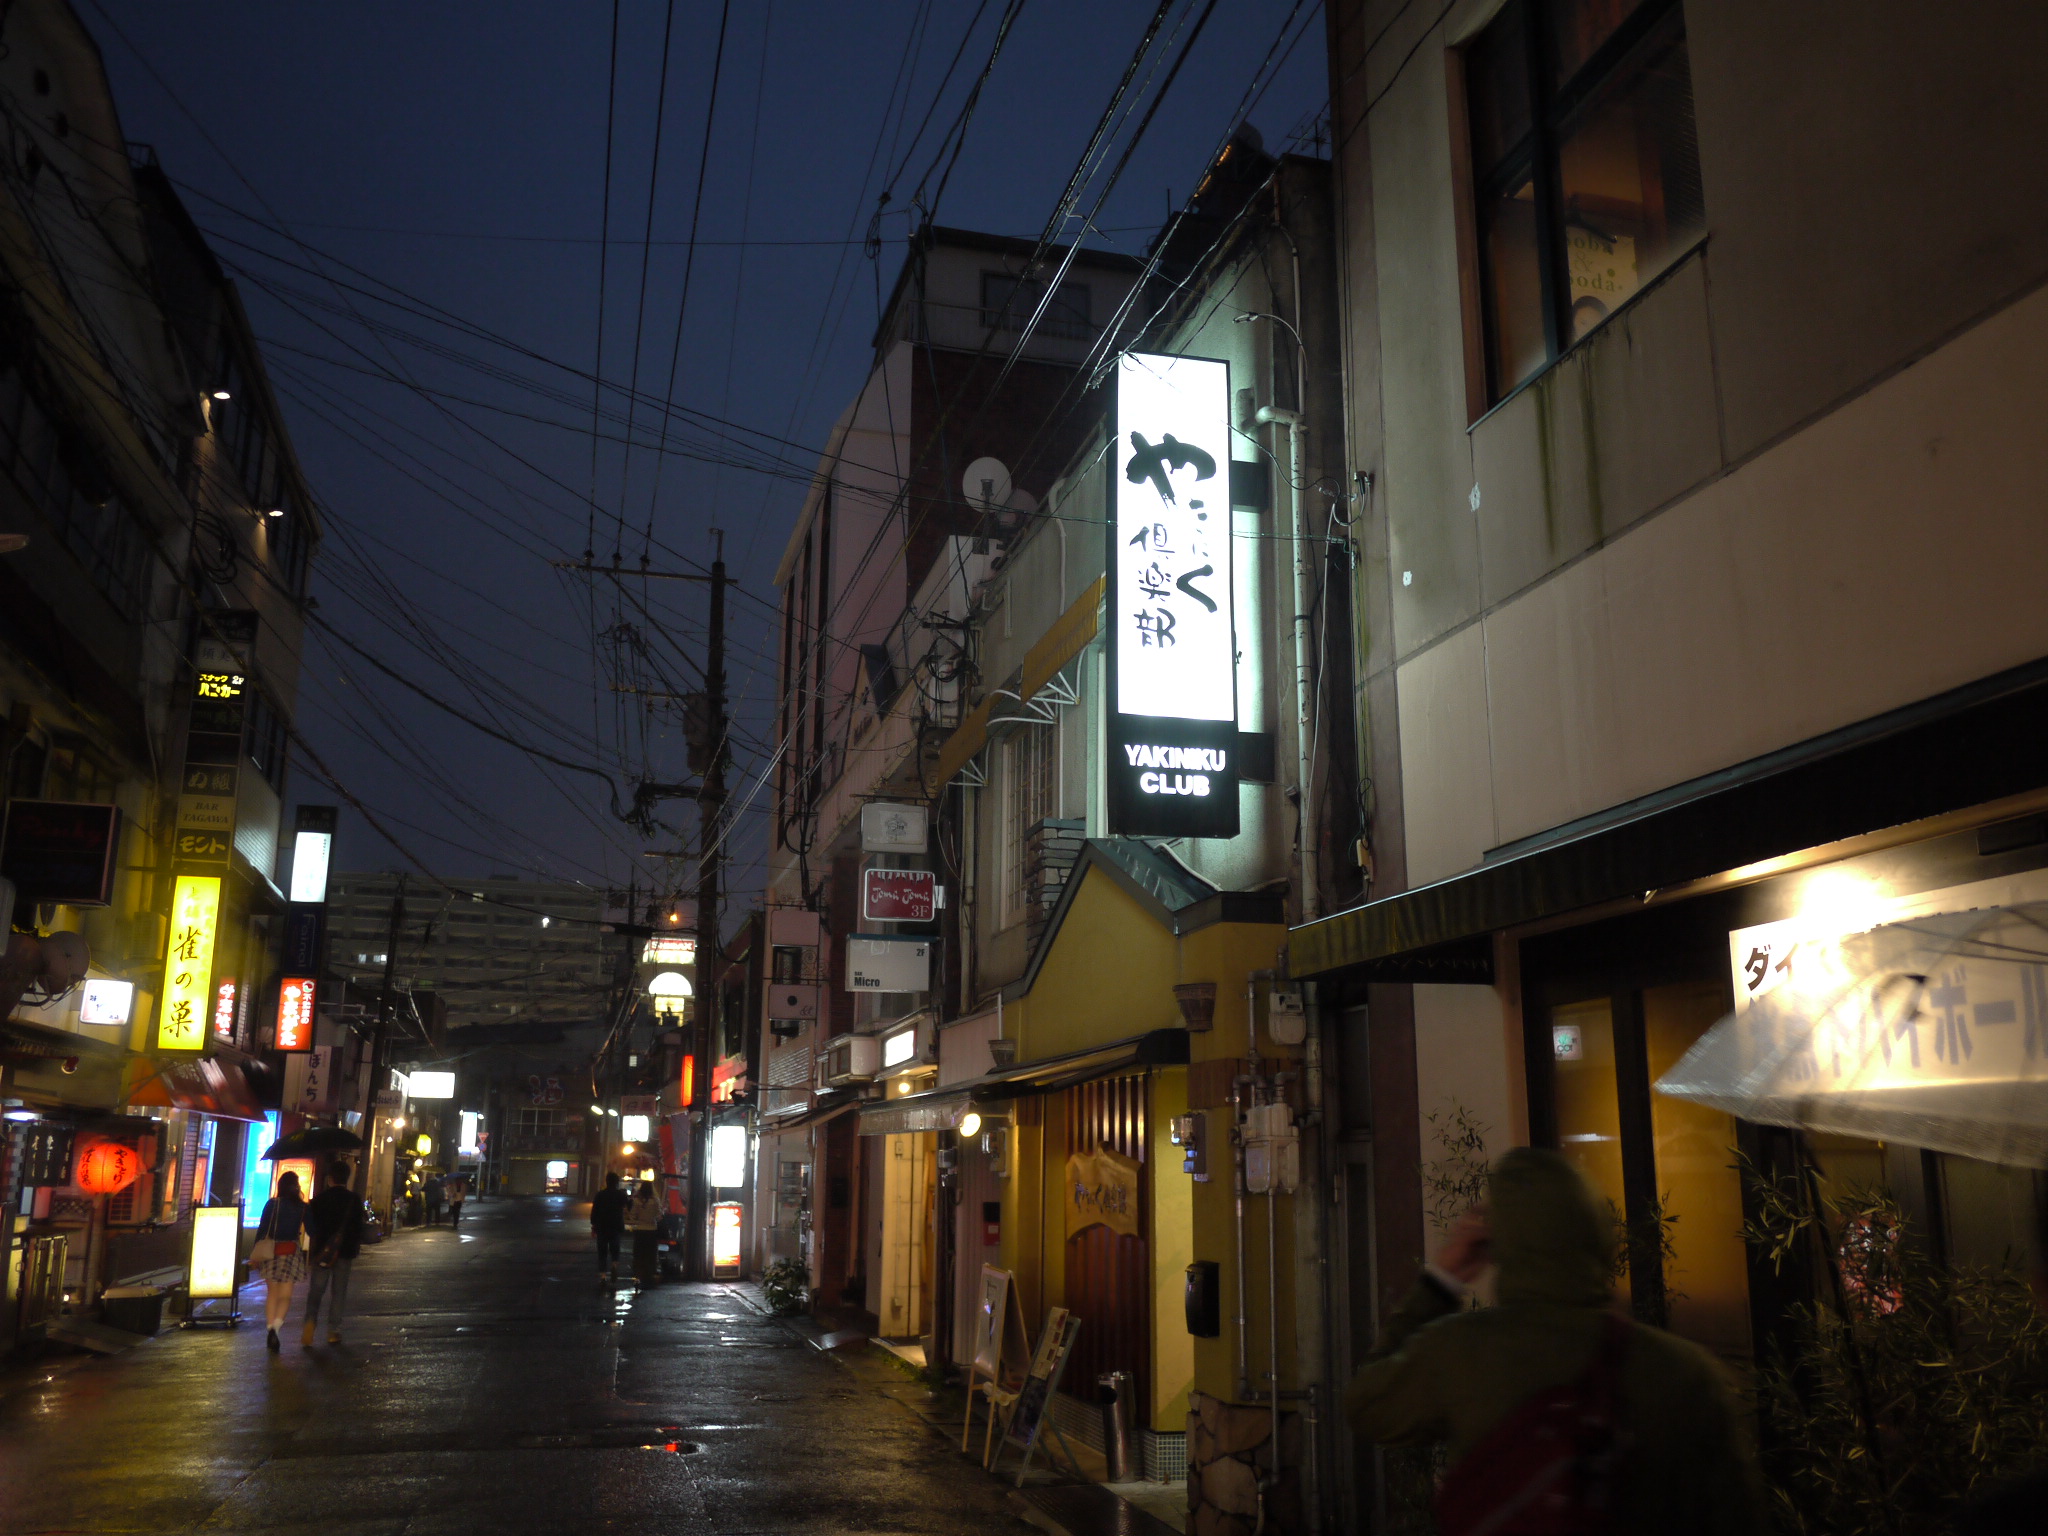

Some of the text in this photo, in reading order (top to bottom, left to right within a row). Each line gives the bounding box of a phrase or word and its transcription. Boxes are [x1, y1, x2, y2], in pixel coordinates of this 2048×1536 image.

[199, 673, 229, 683] スナック
[1124, 744, 1226, 772] YAKINIKU
[1140, 772, 1211, 797] CLUB
[180, 835, 227, 855] モント
[911, 904, 930, 918] 3F
[916, 948, 925, 957] 2F
[163, 925, 202, 1039] 雀の巣
[854, 976, 880, 987] Micro
[113, 1148, 128, 1185] やきとり
